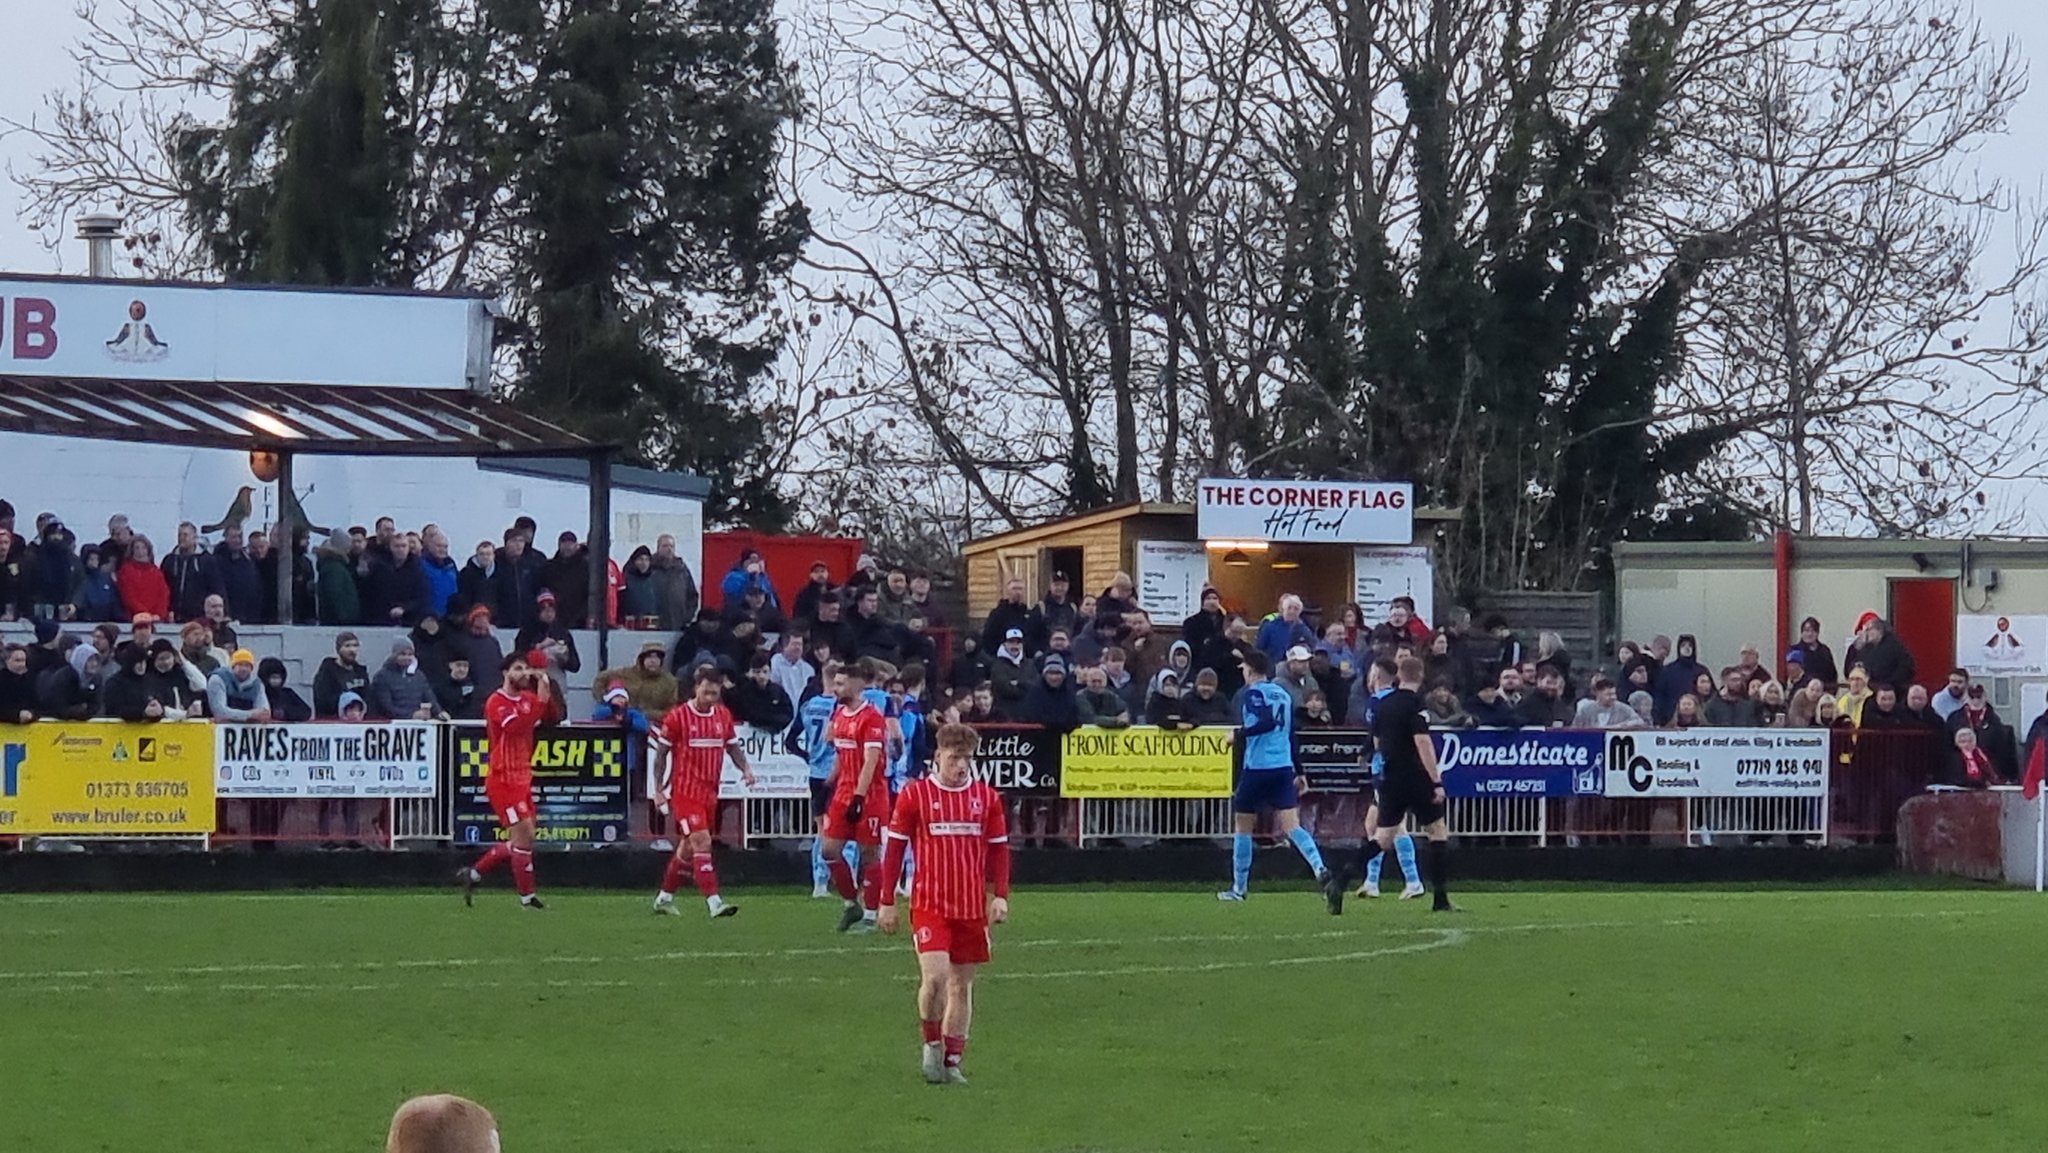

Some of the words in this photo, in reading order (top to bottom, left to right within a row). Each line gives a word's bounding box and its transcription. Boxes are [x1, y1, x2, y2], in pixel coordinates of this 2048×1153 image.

[0, 297, 57, 359] B
[1203, 486, 1245, 506] THE
[1250, 487, 1342, 508] CORNER
[1349, 490, 1405, 510] FLAG
[1264, 503, 1300, 538] Hot
[1301, 507, 1348, 537] Food
[811, 718, 825, 746] 7
[224, 728, 289, 761] RAVES
[292, 737, 330, 761] FROM
[334, 737, 362, 761] THE
[364, 728, 427, 761] GRAVE
[531, 740, 588, 766] ASH
[975, 735, 1036, 757] Little
[1066, 734, 1119, 756] FROME
[1124, 734, 1230, 756] SCAFFOLDING
[1436, 732, 1588, 775] Domesticare
[308, 766, 336, 780] VINYL
[1657, 758, 1691, 773] Roofing
[1737, 759, 1771, 775] 07719
[86, 782, 130, 798] 01373
[52, 808, 187, 824] www.bruler.co.uk
